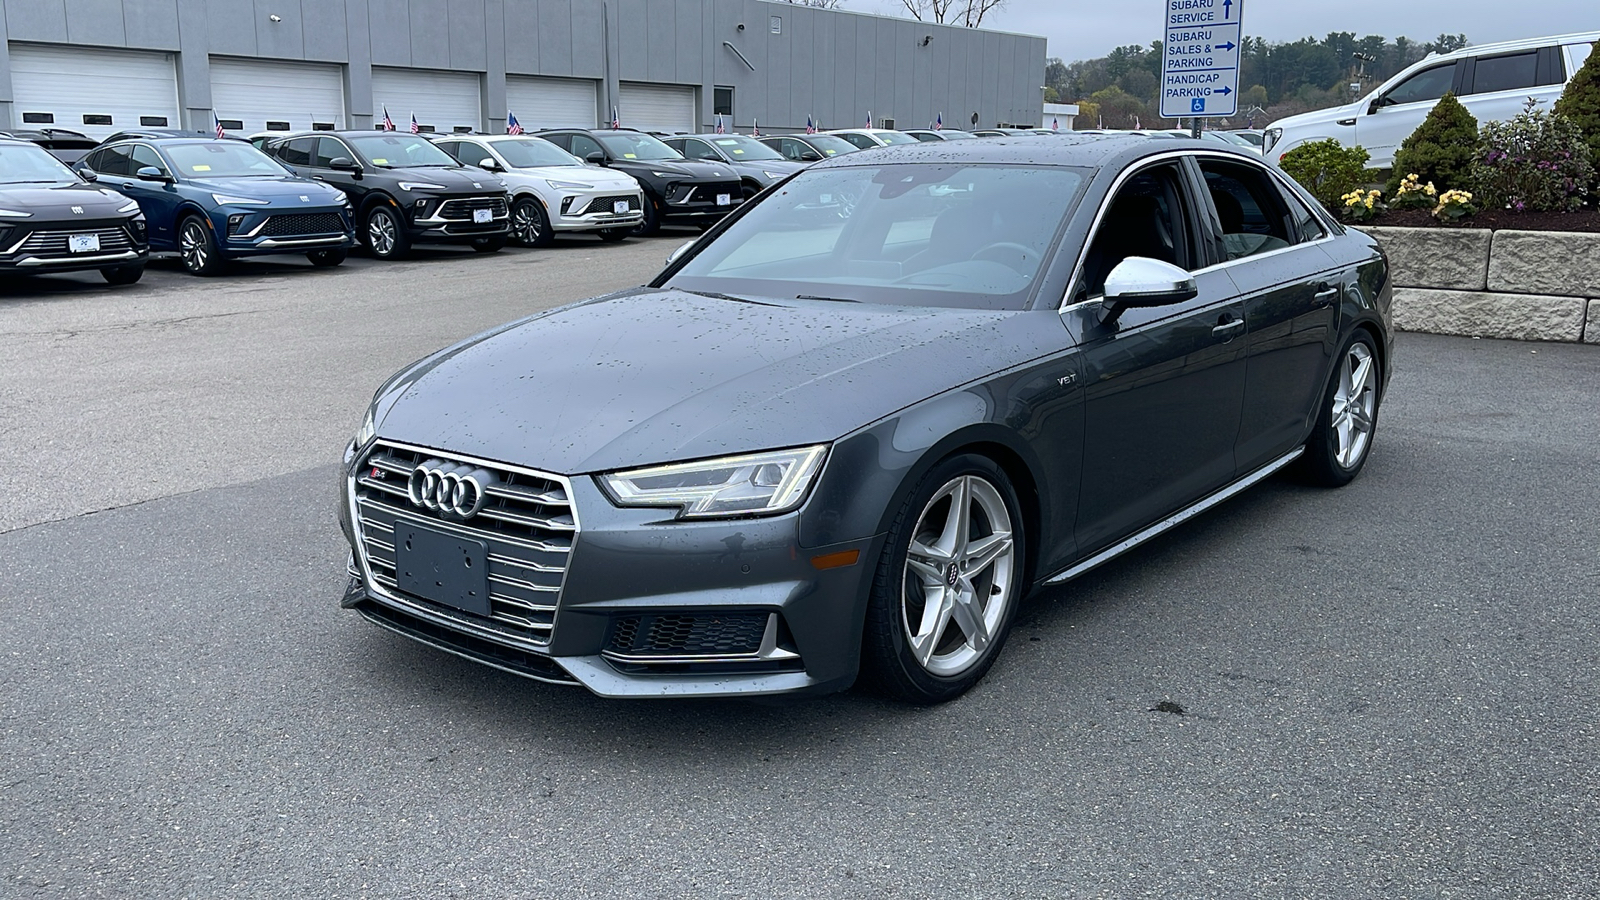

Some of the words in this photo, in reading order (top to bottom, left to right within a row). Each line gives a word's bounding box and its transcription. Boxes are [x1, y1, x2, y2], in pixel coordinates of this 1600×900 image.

[1171, 0, 1214, 10] SUBARU
[1170, 12, 1214, 23] SERVICE
[1169, 31, 1212, 42] SUBARU
[1168, 45, 1202, 55] SALES
[1204, 44, 1212, 53] &
[1168, 57, 1213, 68] PARKING
[1167, 74, 1220, 84] HANDICAP
[1166, 87, 1211, 97] PARKING
